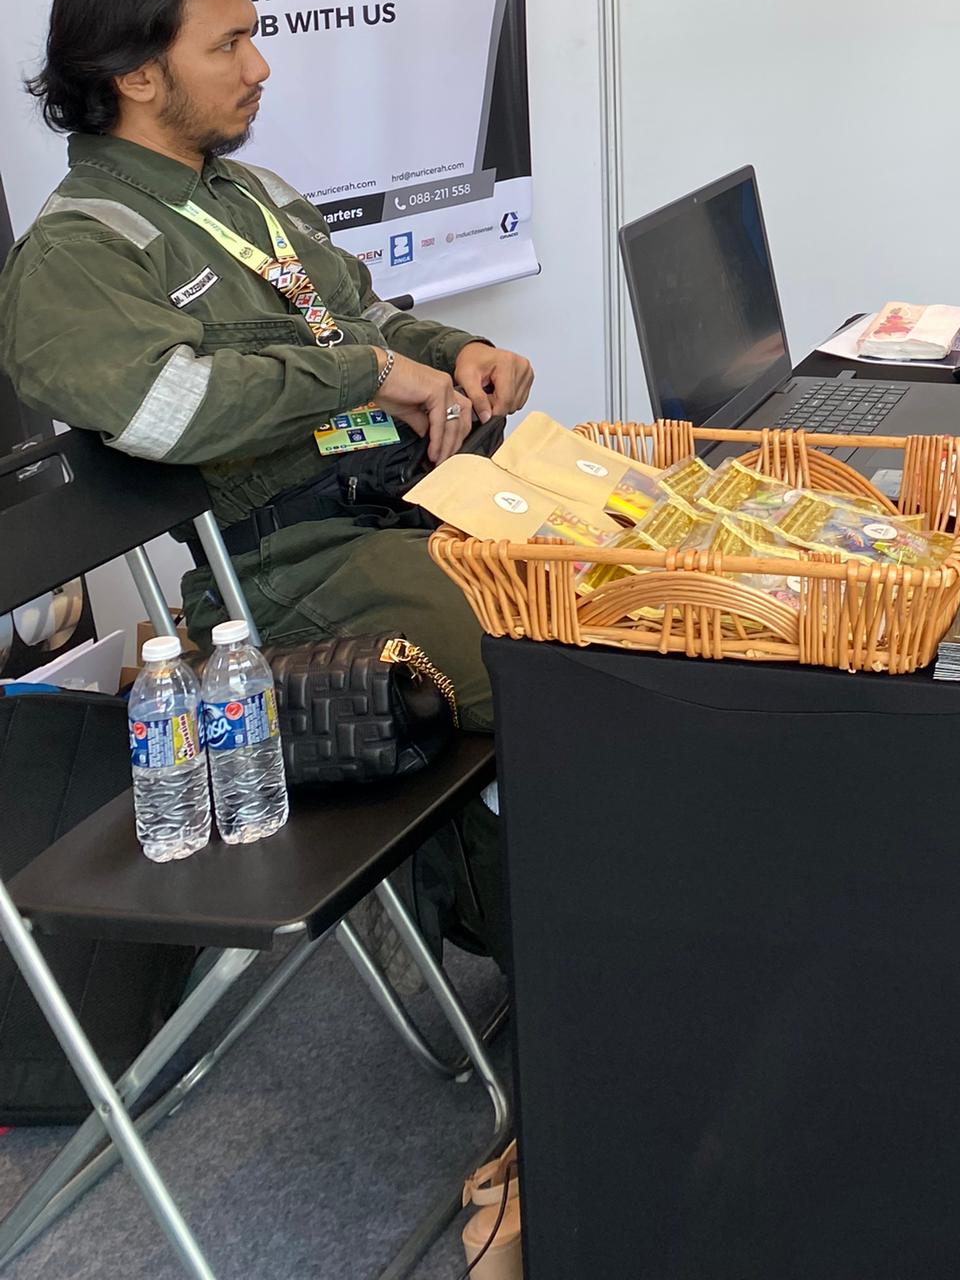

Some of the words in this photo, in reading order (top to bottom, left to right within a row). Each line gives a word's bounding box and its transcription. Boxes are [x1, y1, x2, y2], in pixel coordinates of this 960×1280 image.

[285, 6, 355, 34] WITH
[362, 2, 396, 26] US
[391, 161, 465, 182] hrd@nuricerah.com
[302, 179, 377, 199] ww.nuricerah.com
[409, 187, 449, 206] 088-211
[452, 183, 471, 197] 558
[357, 249, 383, 261] DEN
